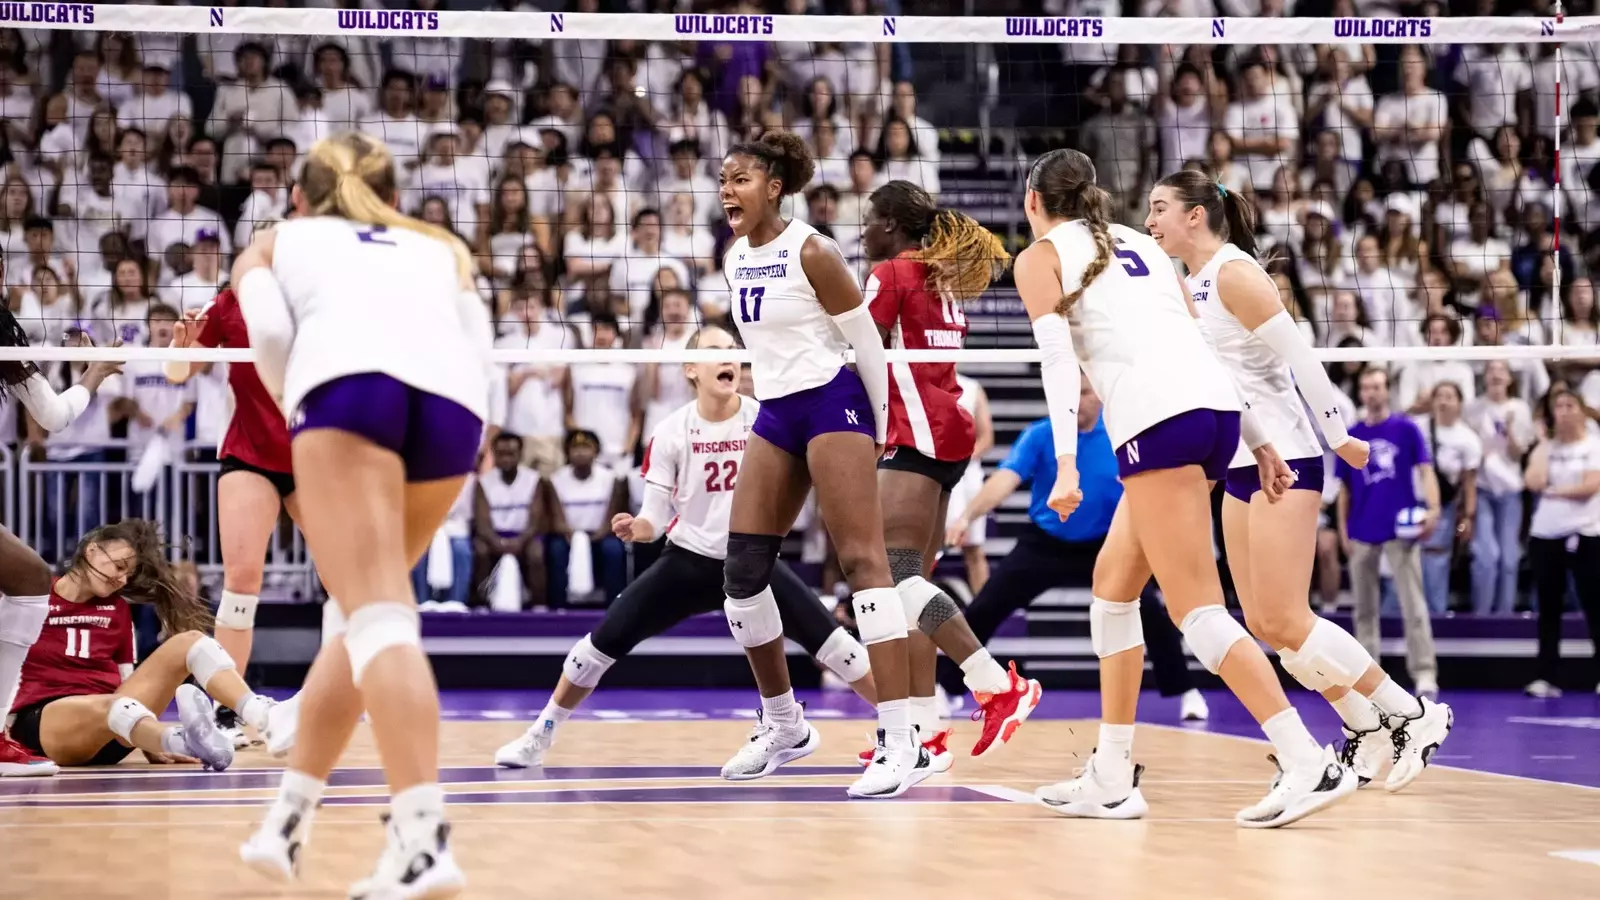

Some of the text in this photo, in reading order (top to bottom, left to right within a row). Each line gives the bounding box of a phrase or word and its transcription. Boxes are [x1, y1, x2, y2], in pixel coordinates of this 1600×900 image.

[210, 7, 223, 26] N
[338, 10, 439, 30] WILDCATS
[551, 13, 564, 31] N
[675, 15, 774, 35] WILDCATS
[883, 17, 896, 36] N
[1006, 17, 1104, 38] WILDCATS
[1211, 19, 1225, 38] N
[1334, 18, 1432, 38] WILDCATS
[1541, 20, 1555, 36] N
[739, 286, 766, 323] 17
[1126, 440, 1141, 465] N
[704, 460, 738, 492] 22
[65, 627, 91, 659] 11
